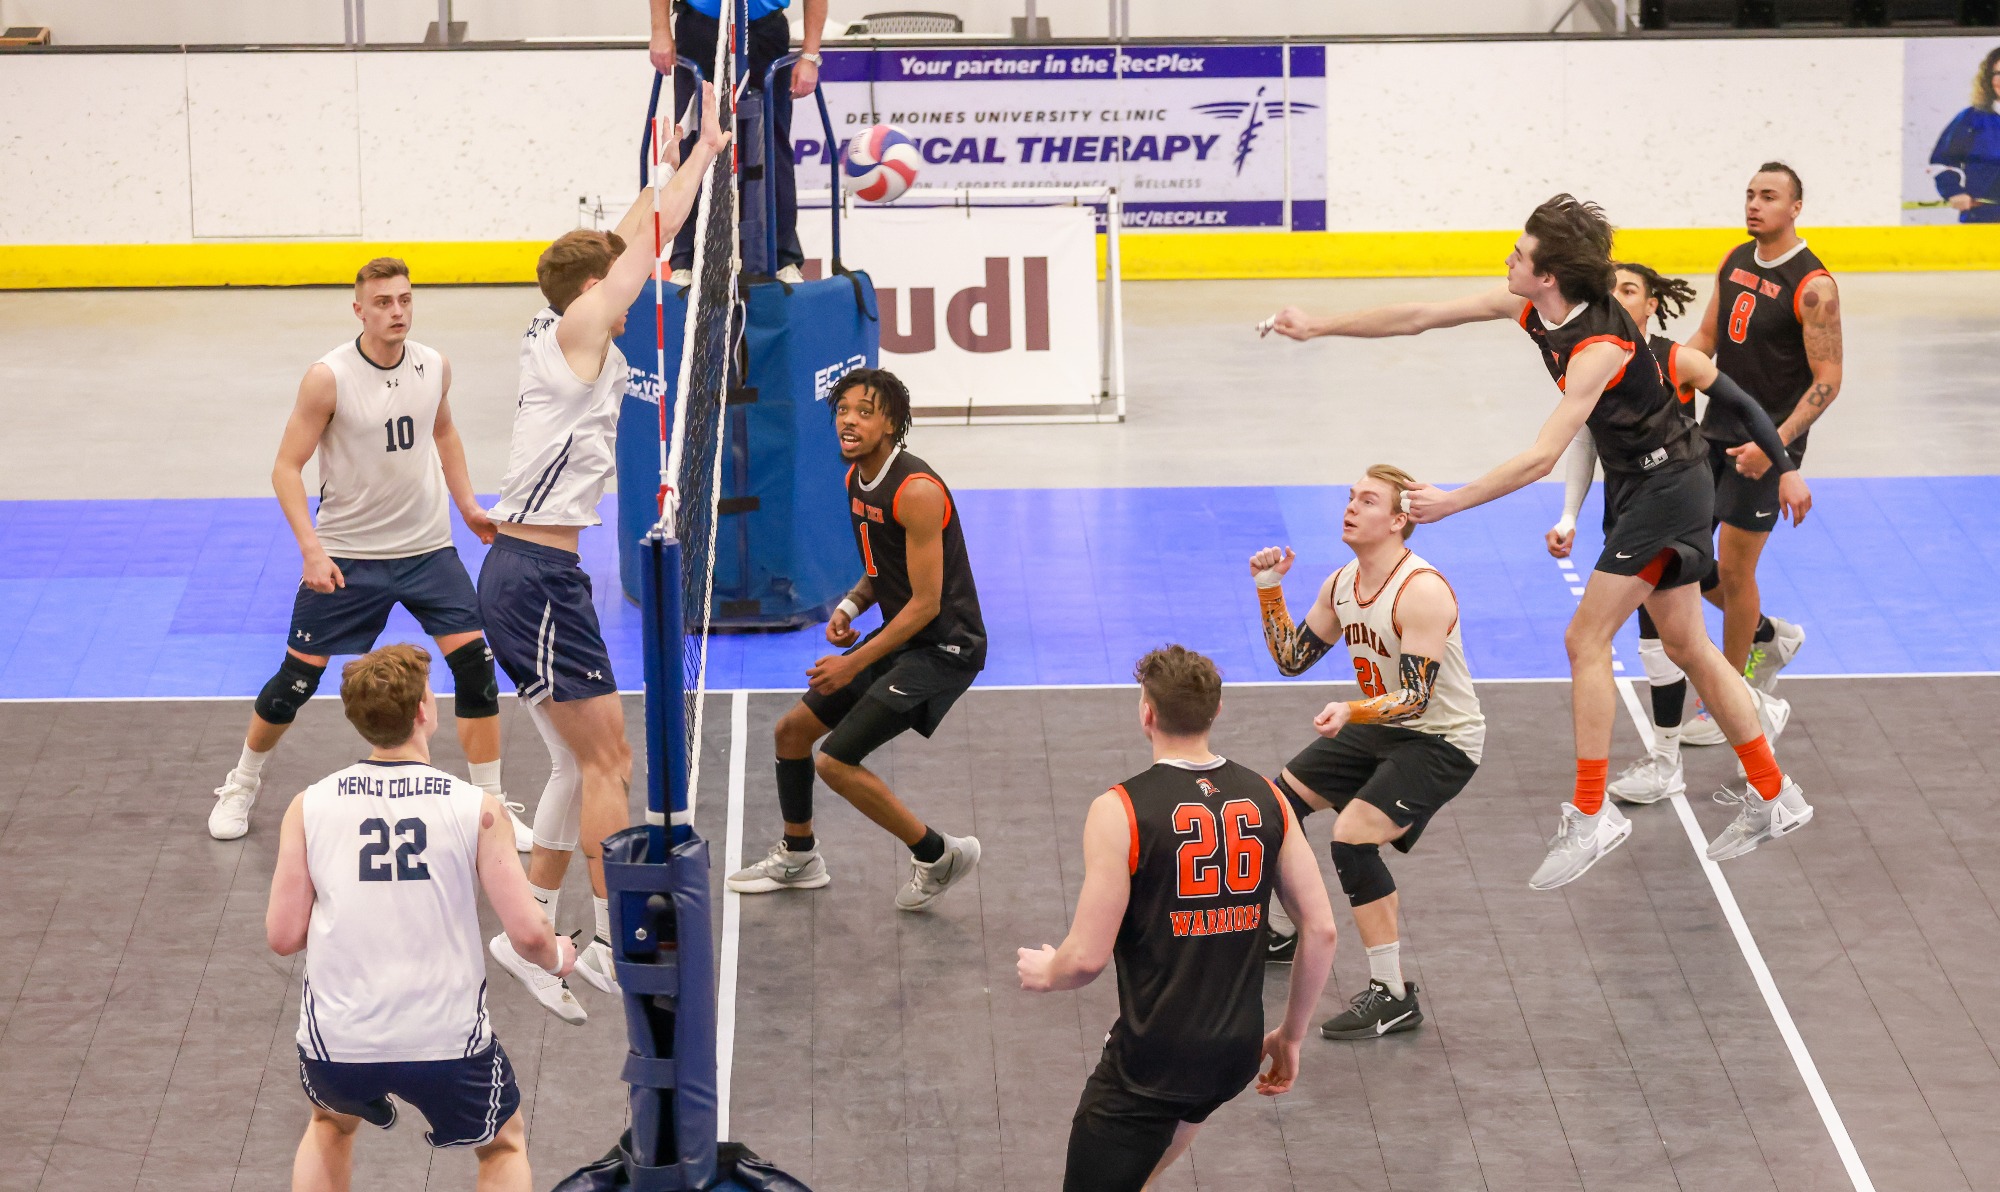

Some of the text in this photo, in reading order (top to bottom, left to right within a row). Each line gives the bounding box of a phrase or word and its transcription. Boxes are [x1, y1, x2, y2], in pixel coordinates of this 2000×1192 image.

[900, 53, 1206, 79] Your partner in the RecPlex
[846, 108, 1168, 124] DES MOINES UNIVERSITY CLINIC
[1017, 135, 1221, 163] THERAPY
[1134, 177, 1203, 189] WELLNESS
[1727, 290, 1756, 345] 8
[384, 415, 415, 452] 10
[860, 521, 878, 577] 1
[1352, 656, 1388, 698] 21
[338, 776, 452, 799] MENLO COLLEGE
[358, 817, 431, 882] 22
[1171, 798, 1265, 899] 26
[1169, 903, 1262, 937] WARRIORS
